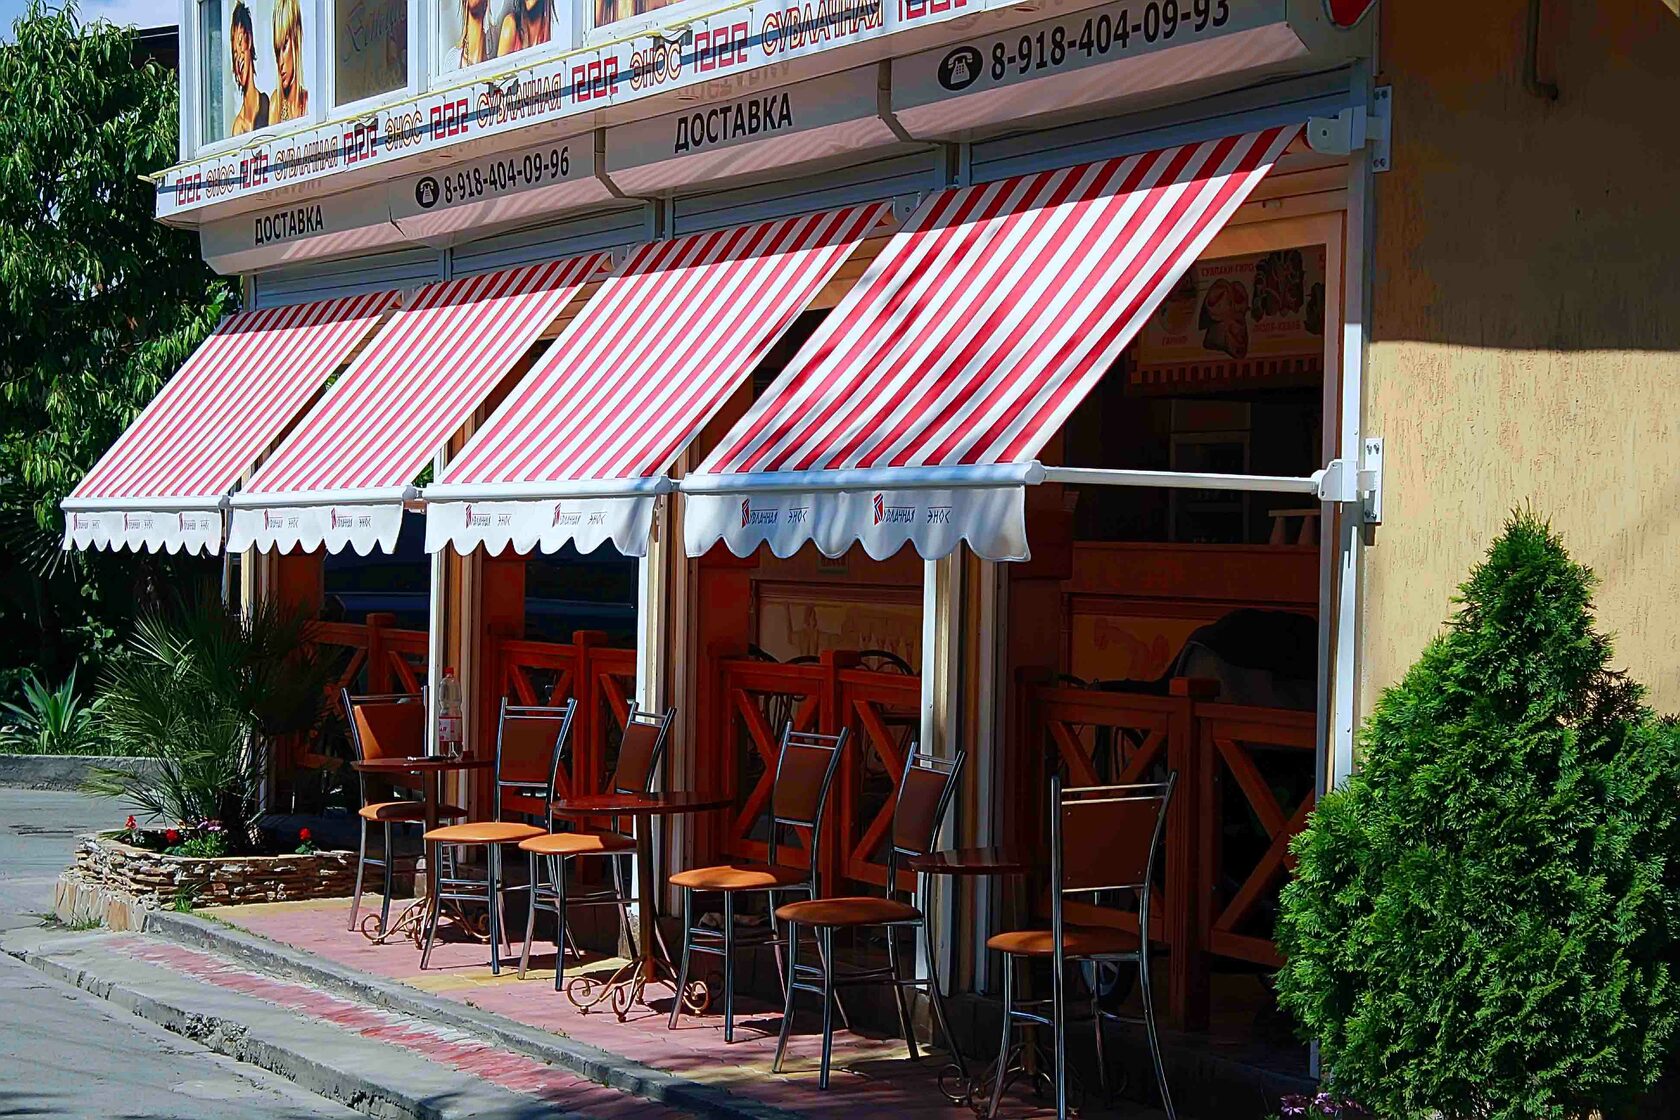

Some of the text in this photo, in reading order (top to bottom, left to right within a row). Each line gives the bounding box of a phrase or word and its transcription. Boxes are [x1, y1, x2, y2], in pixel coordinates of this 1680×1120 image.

[991, 0, 1229, 81] 8-918-404-09-93
[206, 164, 235, 199] ЭНОС
[275, 136, 338, 182] СУВЛАЧНАЯ
[385, 111, 423, 151] ЭНОС
[476, 73, 562, 128] СУВЛАЧНАЯ
[629, 43, 682, 91] ЭНОС
[761, 0, 884, 57] СУВЛАЧНАЯ
[674, 92, 793, 153] ДОСТАВКА
[444, 147, 569, 203] 8-918-404-09-96
[254, 204, 324, 245] ДОСТАВКА
[787, 508, 809, 524] ЭНОС
[926, 508, 951, 524] ЭНОС
